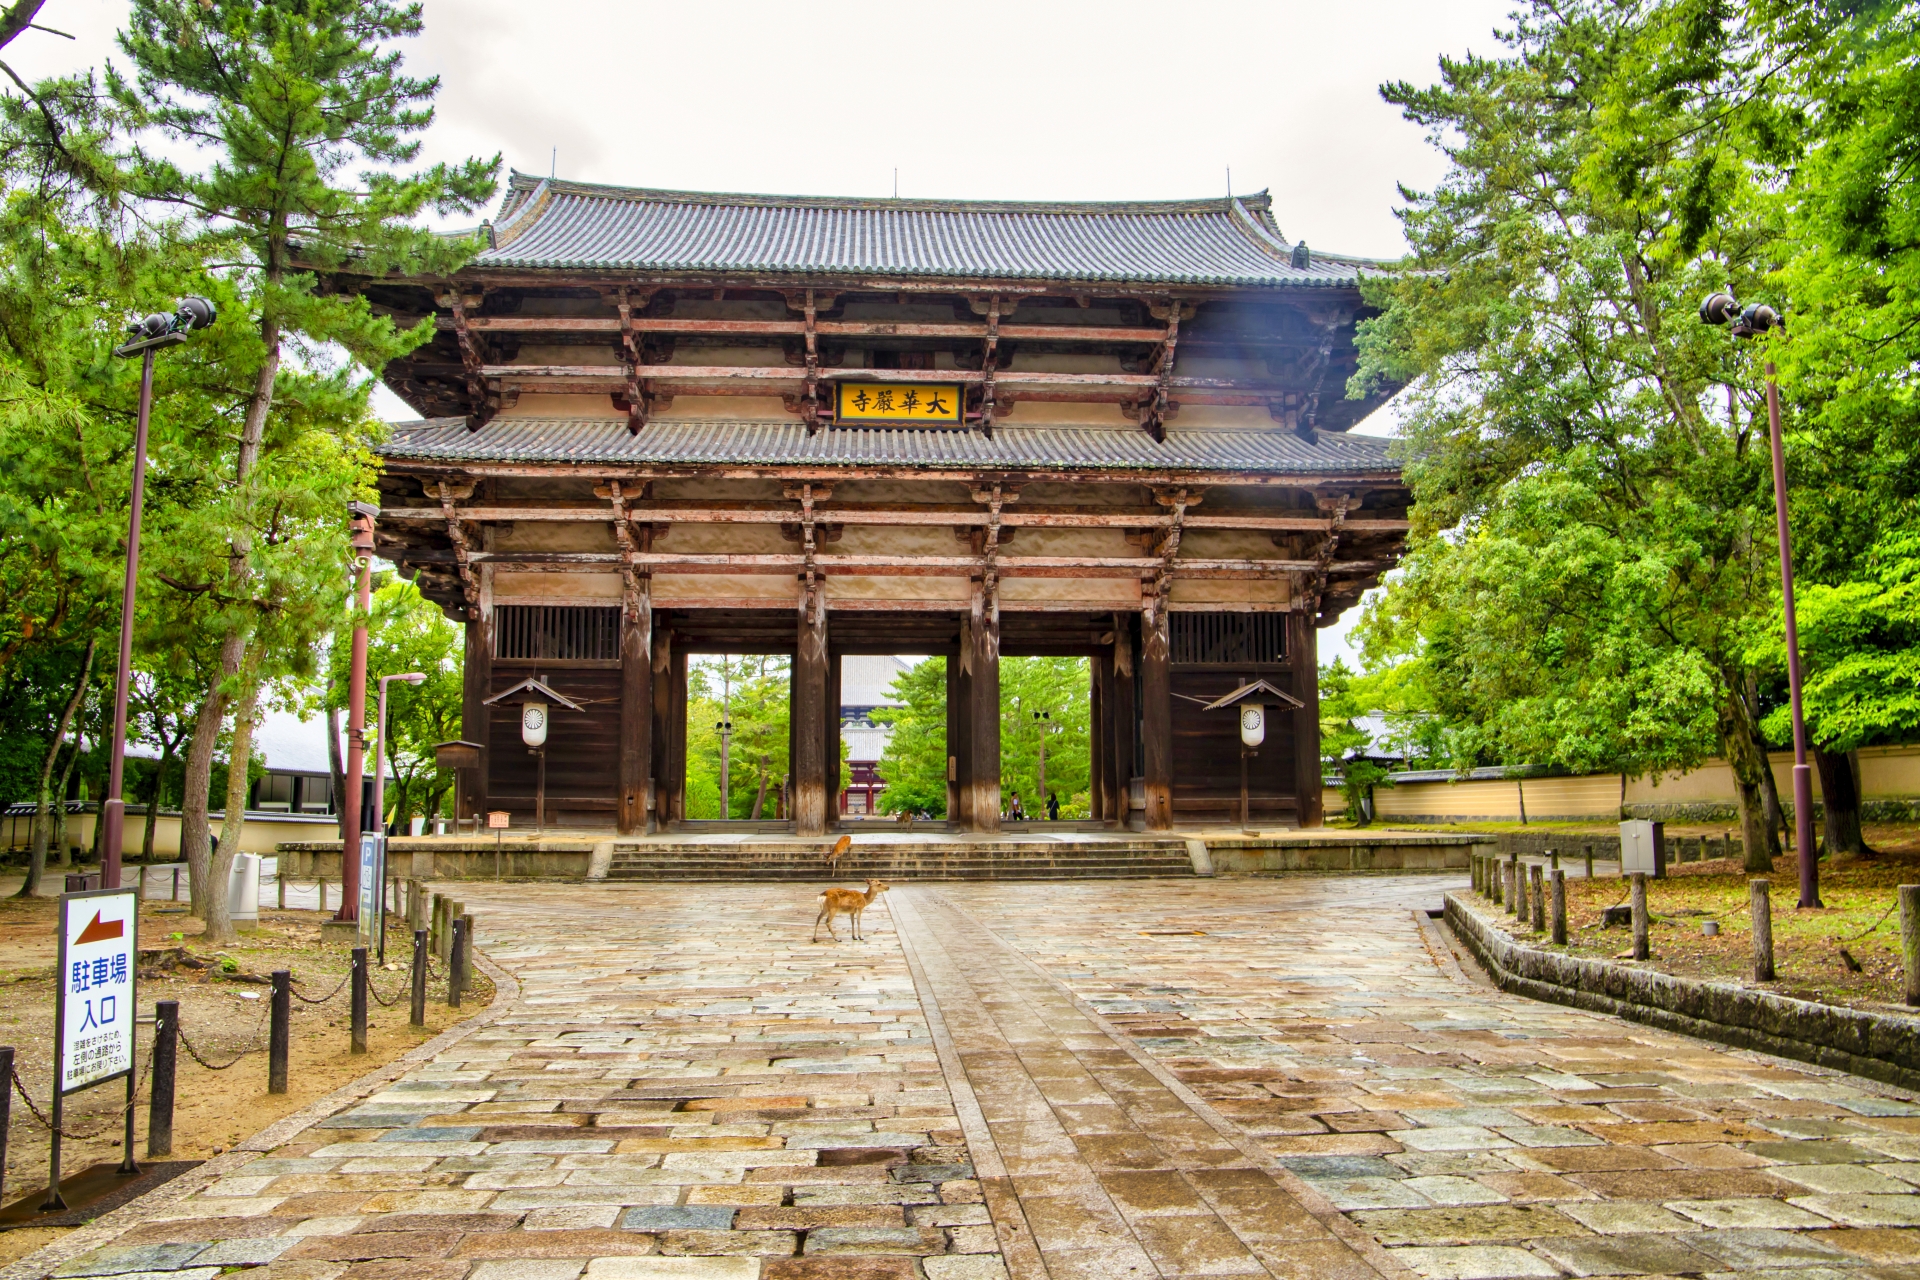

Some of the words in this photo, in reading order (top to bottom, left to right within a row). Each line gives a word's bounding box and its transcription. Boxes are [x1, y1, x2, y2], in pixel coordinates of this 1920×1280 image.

[851, 389, 951, 415] 大華嚴寺
[365, 846, 372, 862] P
[71, 953, 128, 994] 駐車場
[79, 995, 116, 1033] 入口
[73, 1041, 122, 1066] 左側の通路から
